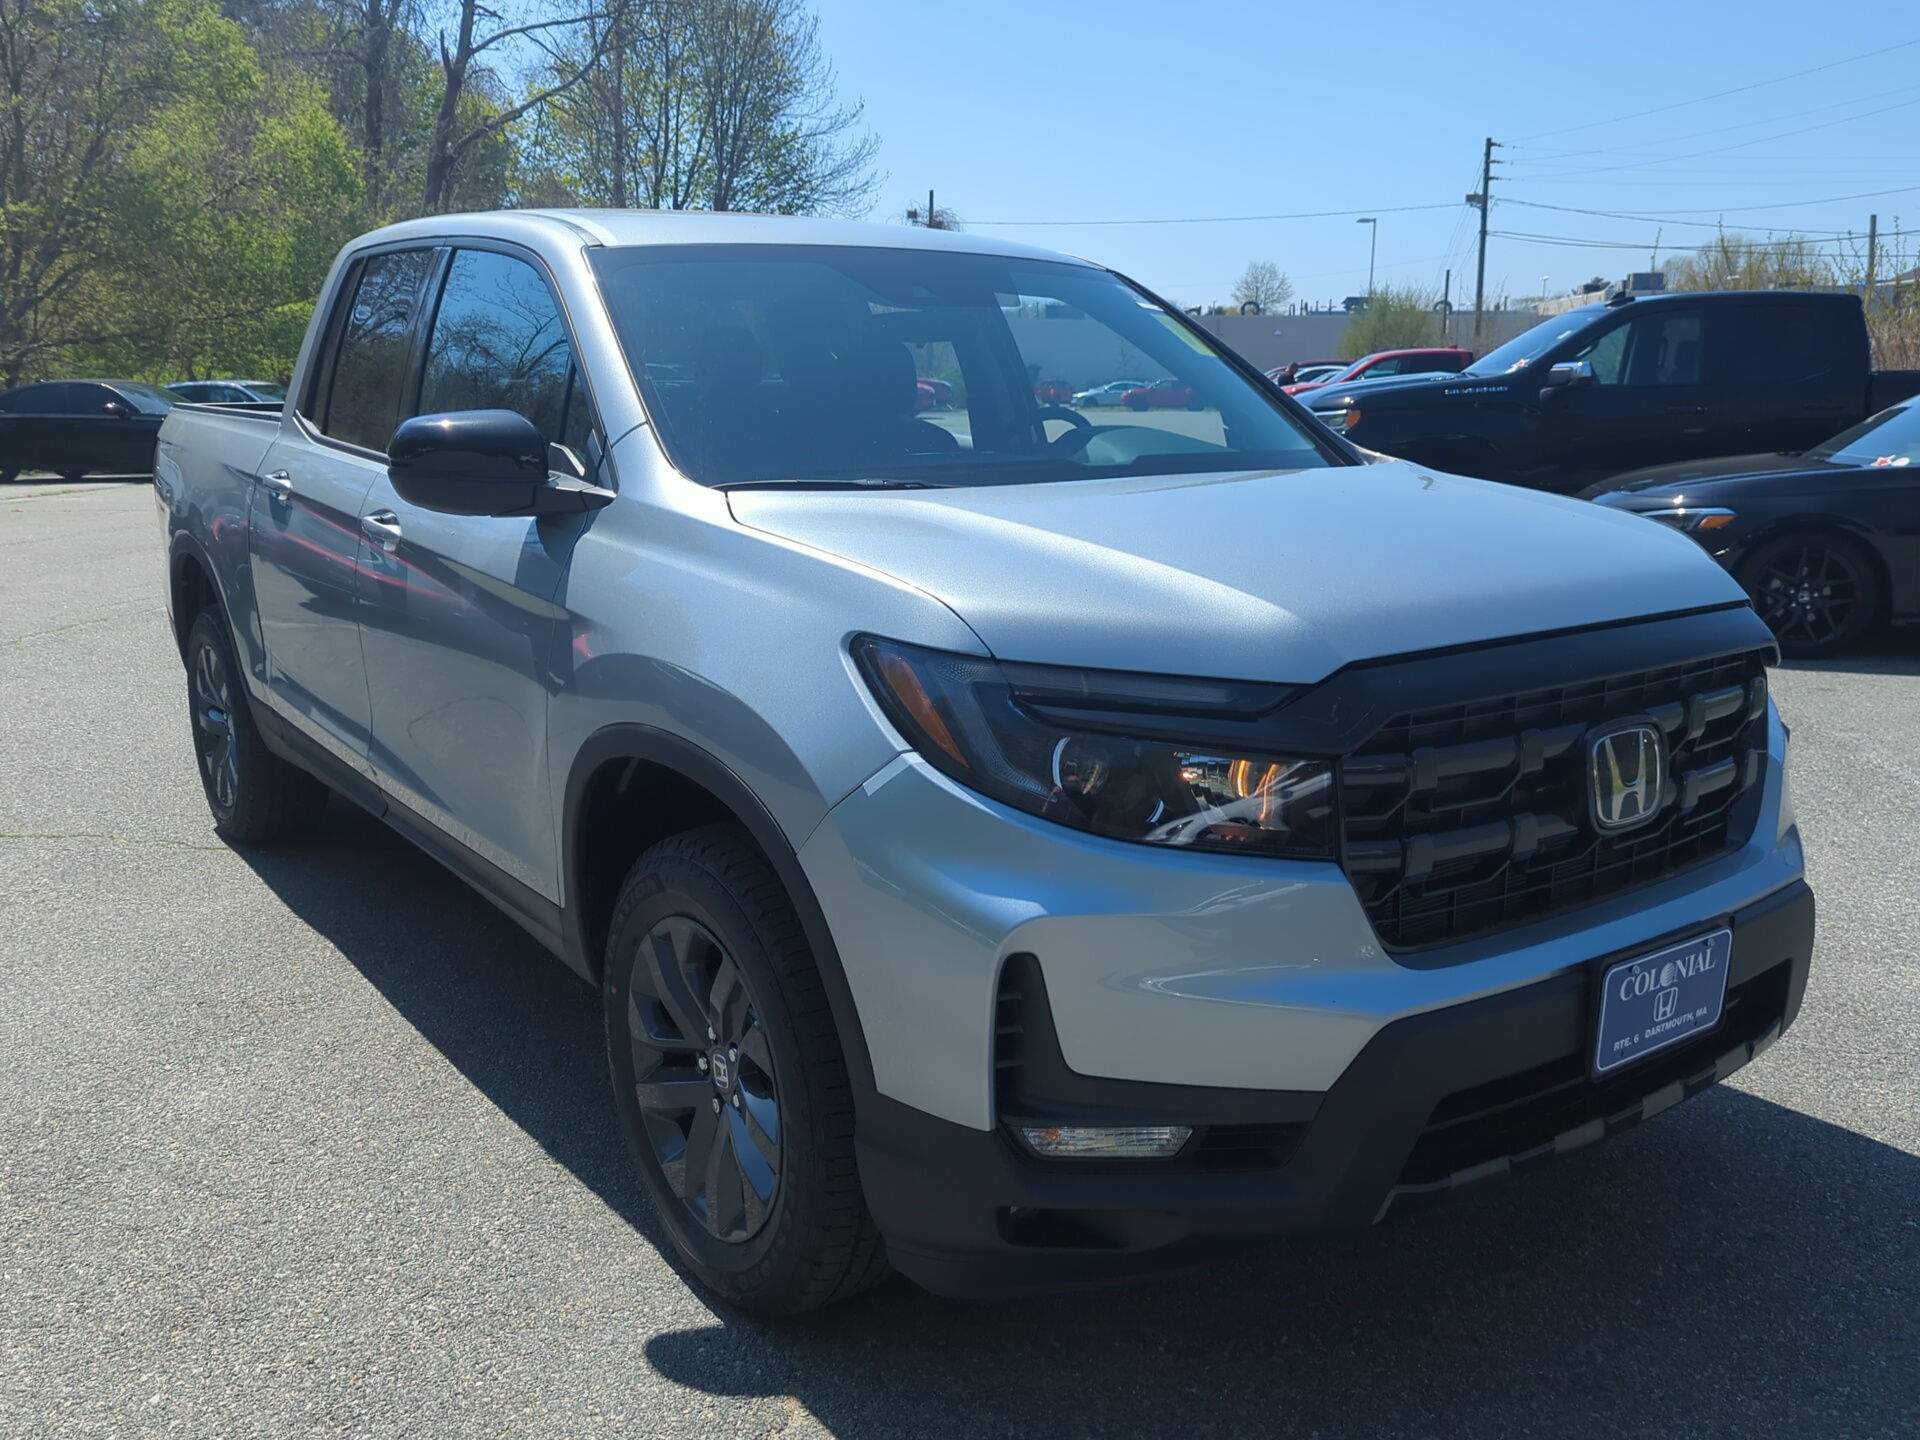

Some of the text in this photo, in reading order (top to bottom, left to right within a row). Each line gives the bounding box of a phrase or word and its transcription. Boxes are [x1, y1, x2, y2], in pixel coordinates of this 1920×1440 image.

[1620, 948, 1716, 1001] COLONIAL
[1613, 1006, 1708, 1051] RTE. 6 DARTMOUTH, MA
